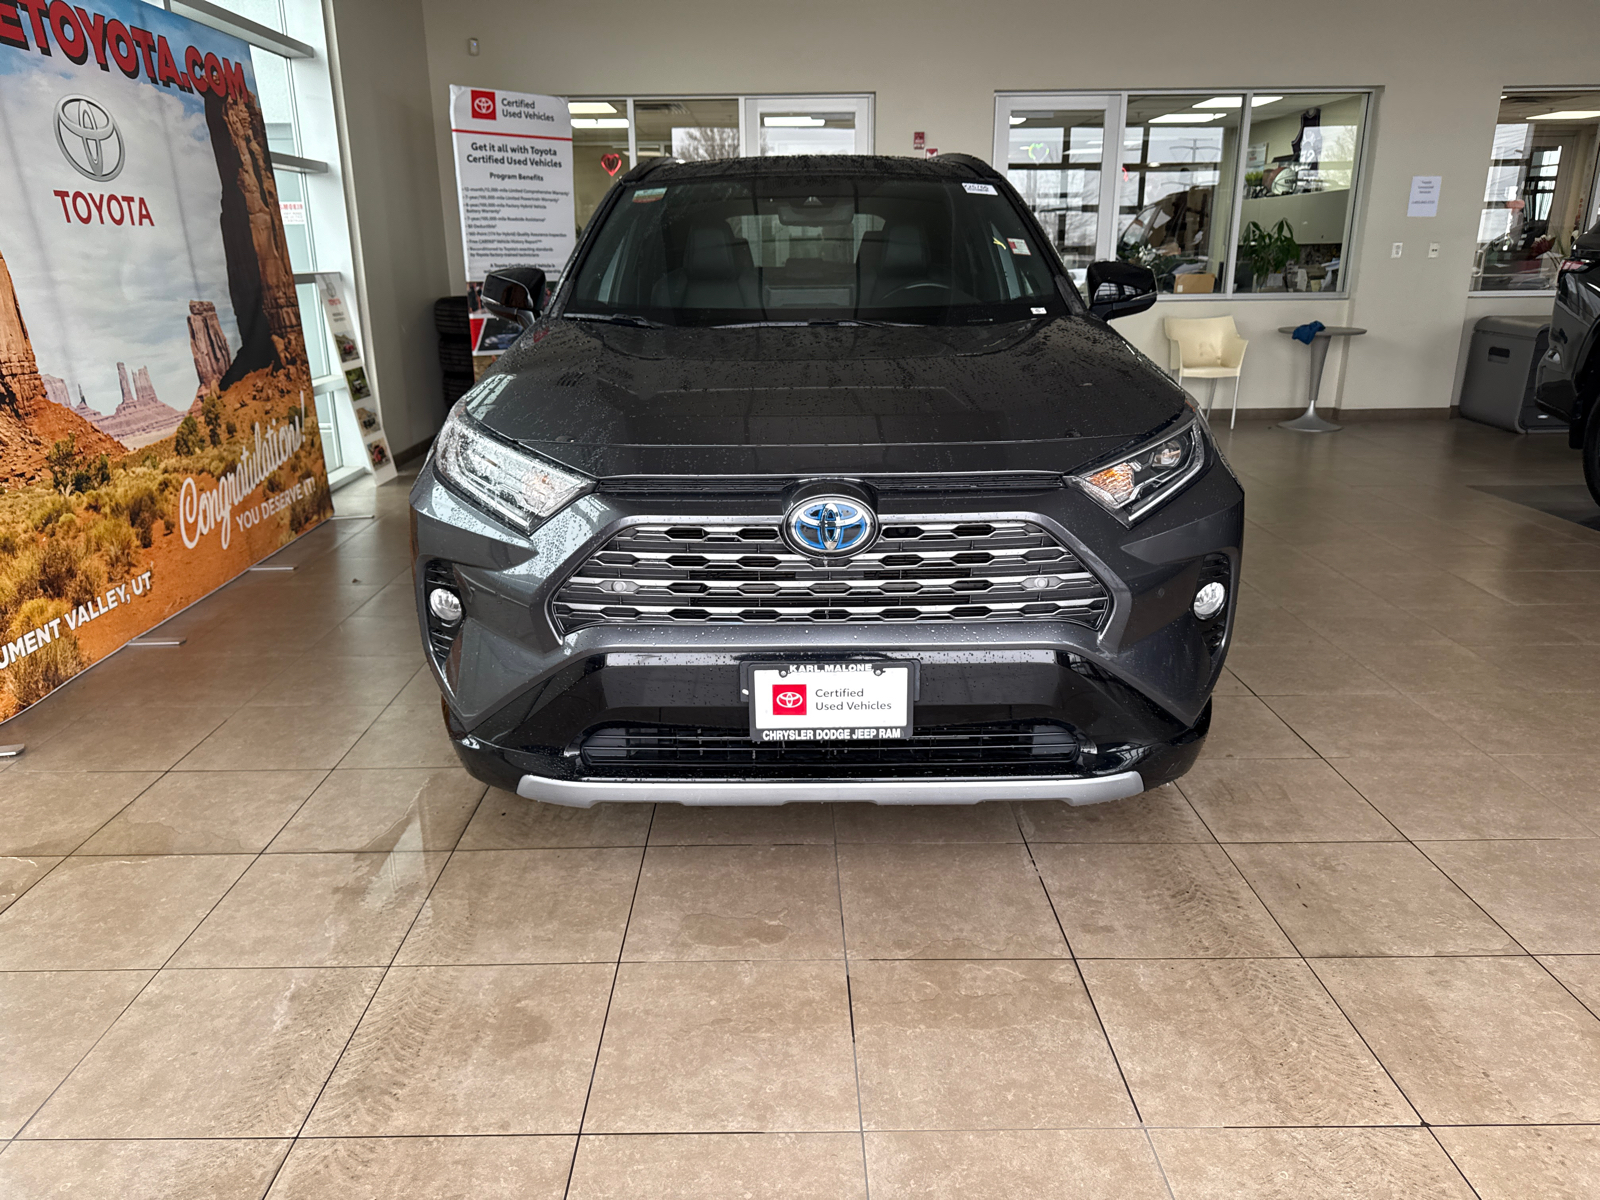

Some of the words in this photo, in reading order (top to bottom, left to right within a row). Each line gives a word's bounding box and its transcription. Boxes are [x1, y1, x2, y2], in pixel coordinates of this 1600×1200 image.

[501, 98, 536, 109] Certified
[502, 110, 522, 118] Used
[524, 111, 554, 122] Vehicles
[471, 142, 487, 152] Get
[488, 143, 496, 152] it
[498, 144, 508, 153] all
[510, 145, 529, 155] with
[530, 146, 557, 157] Toyota
[467, 154, 505, 164] Certified
[507, 157, 528, 166] Used
[529, 158, 562, 168] Vehicles
[490, 172, 516, 182] Program
[518, 173, 544, 182] Benefits
[53, 190, 155, 226] TOYOTA
[180, 390, 306, 550] Congratulations!
[236, 506, 260, 532] YOU
[260, 483, 303, 520] DESERVE
[303, 476, 316, 496] IT!
[64, 584, 131, 631] VALLEY,
[131, 571, 152, 596] UT
[790, 664, 821, 673] KARL
[824, 664, 872, 672] MALONE
[815, 688, 864, 698] Certified
[815, 702, 844, 711] Used
[847, 700, 892, 711] Vehicles
[762, 730, 814, 741] CHRYSLER
[816, 730, 850, 740] DODGE
[852, 729, 876, 740] JEEP
[878, 728, 900, 738] RAM
